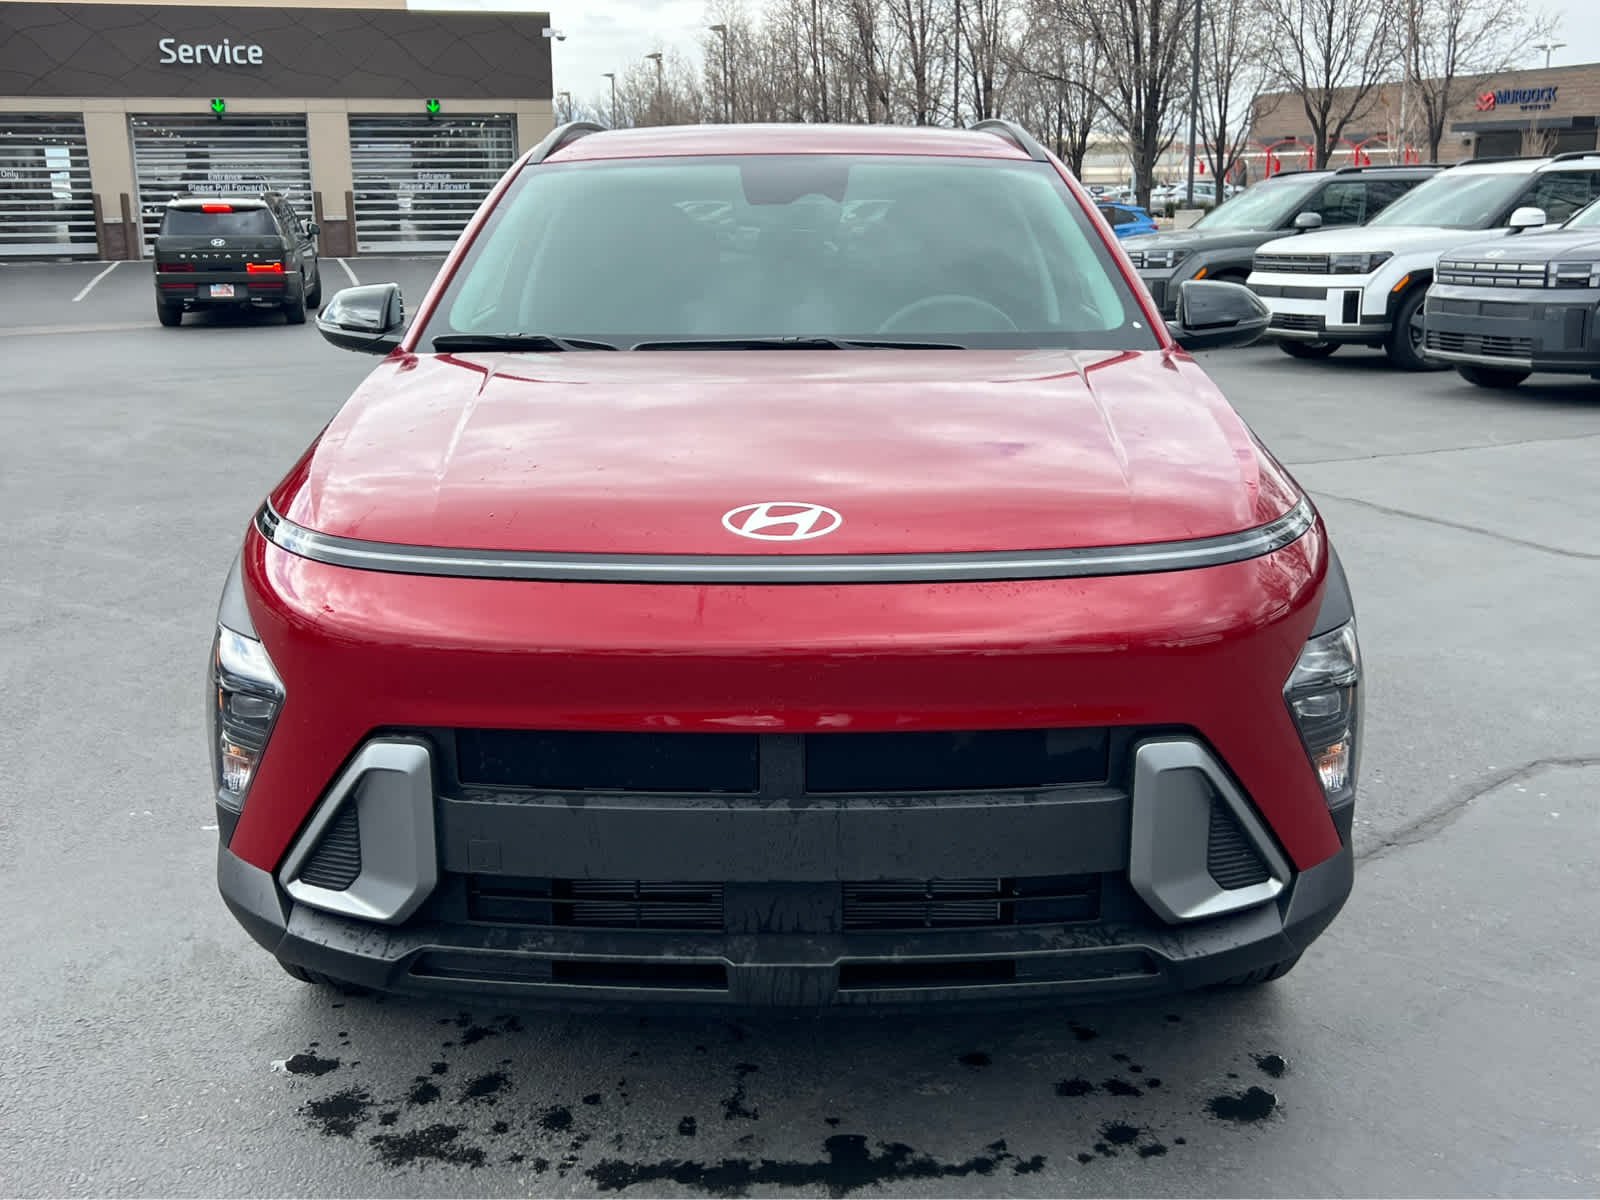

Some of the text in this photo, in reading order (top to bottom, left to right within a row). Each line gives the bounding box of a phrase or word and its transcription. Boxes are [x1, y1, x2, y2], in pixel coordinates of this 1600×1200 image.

[158, 38, 264, 65] Service
[1, 168, 19, 181] Only
[215, 182, 231, 192] Pull
